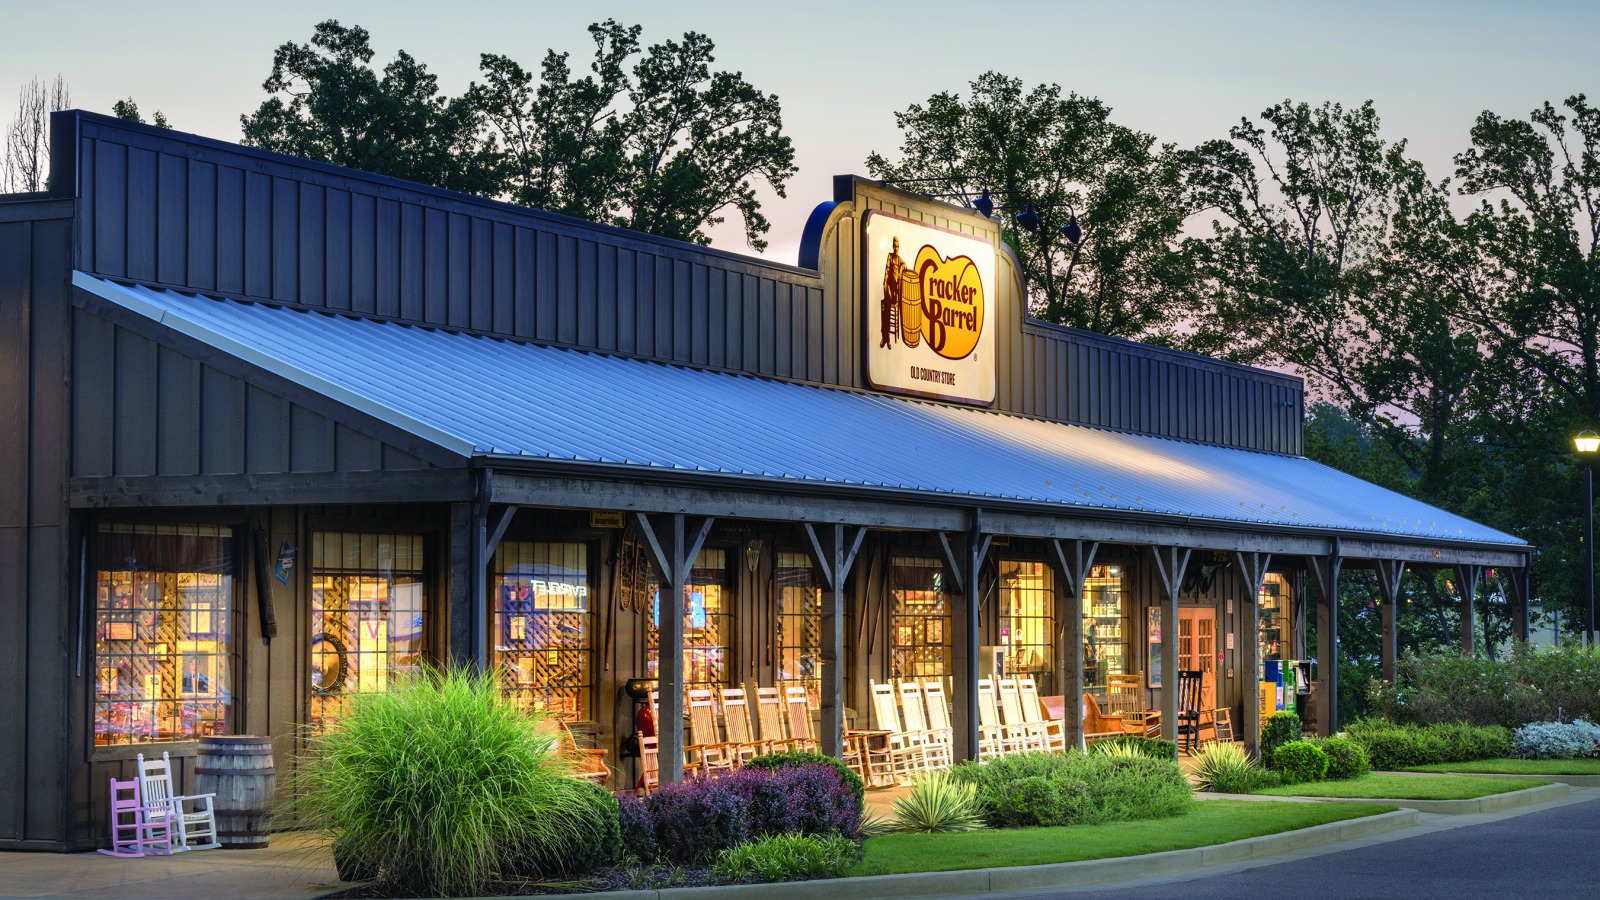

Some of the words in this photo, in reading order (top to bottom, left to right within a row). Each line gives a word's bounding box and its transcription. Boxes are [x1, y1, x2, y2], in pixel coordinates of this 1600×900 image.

[919, 259, 977, 320] Cracker
[929, 298, 977, 351] Barrel
[911, 366, 919, 379] OLD
[920, 367, 941, 383] COUNTRY
[941, 371, 956, 385] STORE
